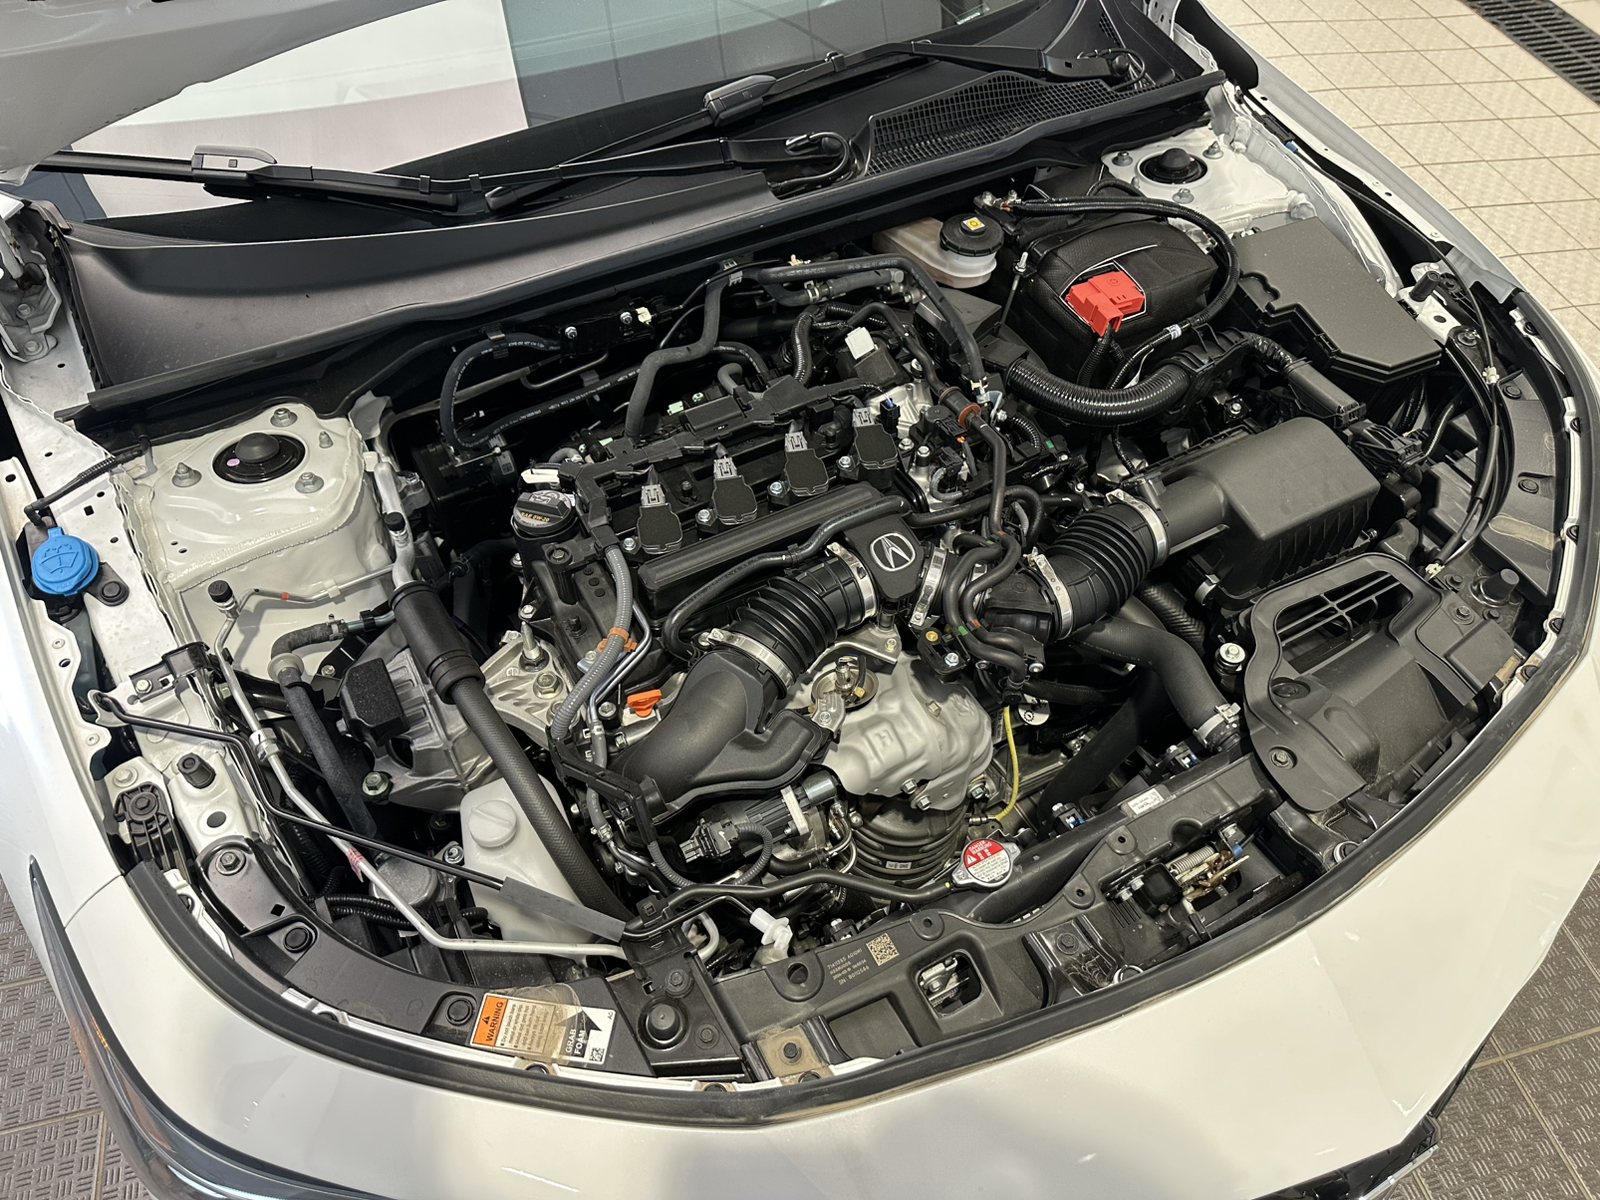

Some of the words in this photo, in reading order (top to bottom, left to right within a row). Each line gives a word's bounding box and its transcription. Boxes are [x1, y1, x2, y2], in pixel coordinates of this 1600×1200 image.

[485, 1001, 504, 1042] WARNING
[500, 1035, 508, 1043] Do
[565, 1028, 577, 1053] GRAB
[573, 1029, 586, 1055] FOAM
